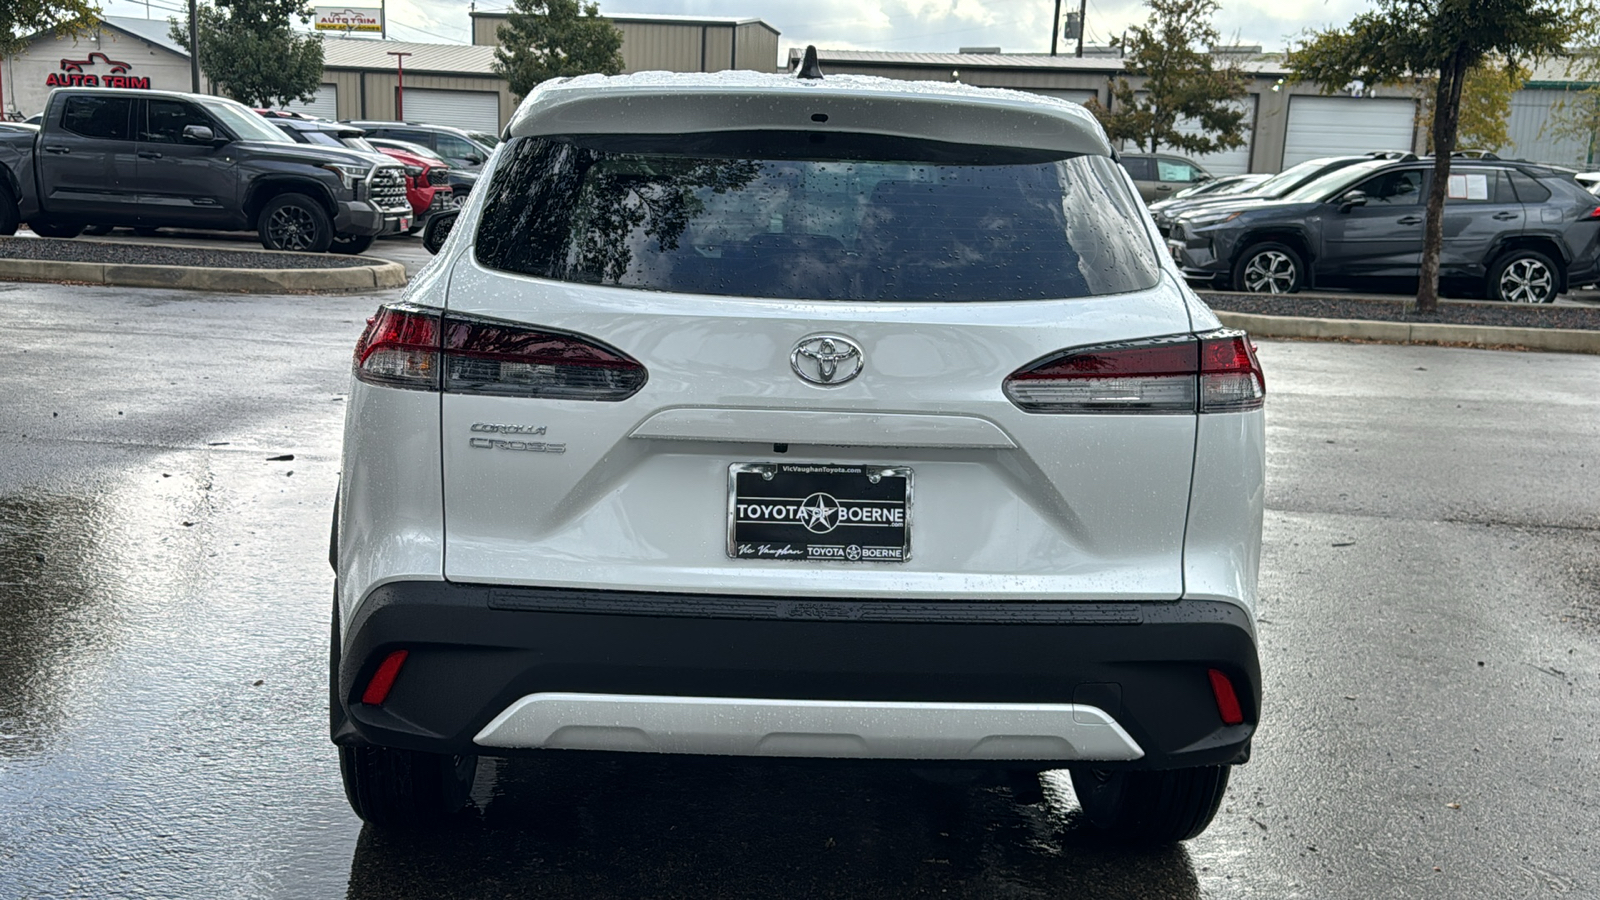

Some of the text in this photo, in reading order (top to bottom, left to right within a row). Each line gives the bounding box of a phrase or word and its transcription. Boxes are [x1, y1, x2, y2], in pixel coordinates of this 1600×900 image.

[46, 73, 150, 89] AUTO TRIM
[470, 422, 547, 435] COROLLA
[469, 437, 567, 453] CROSS
[782, 465, 862, 474] VicVaughanToyota.com
[737, 504, 809, 520] TOYOTA
[838, 506, 904, 522] BOERNE
[738, 543, 755, 556] Vic
[757, 544, 804, 557] Vaughan
[807, 547, 845, 556] TOYOTA
[862, 549, 902, 558] BOERNE
